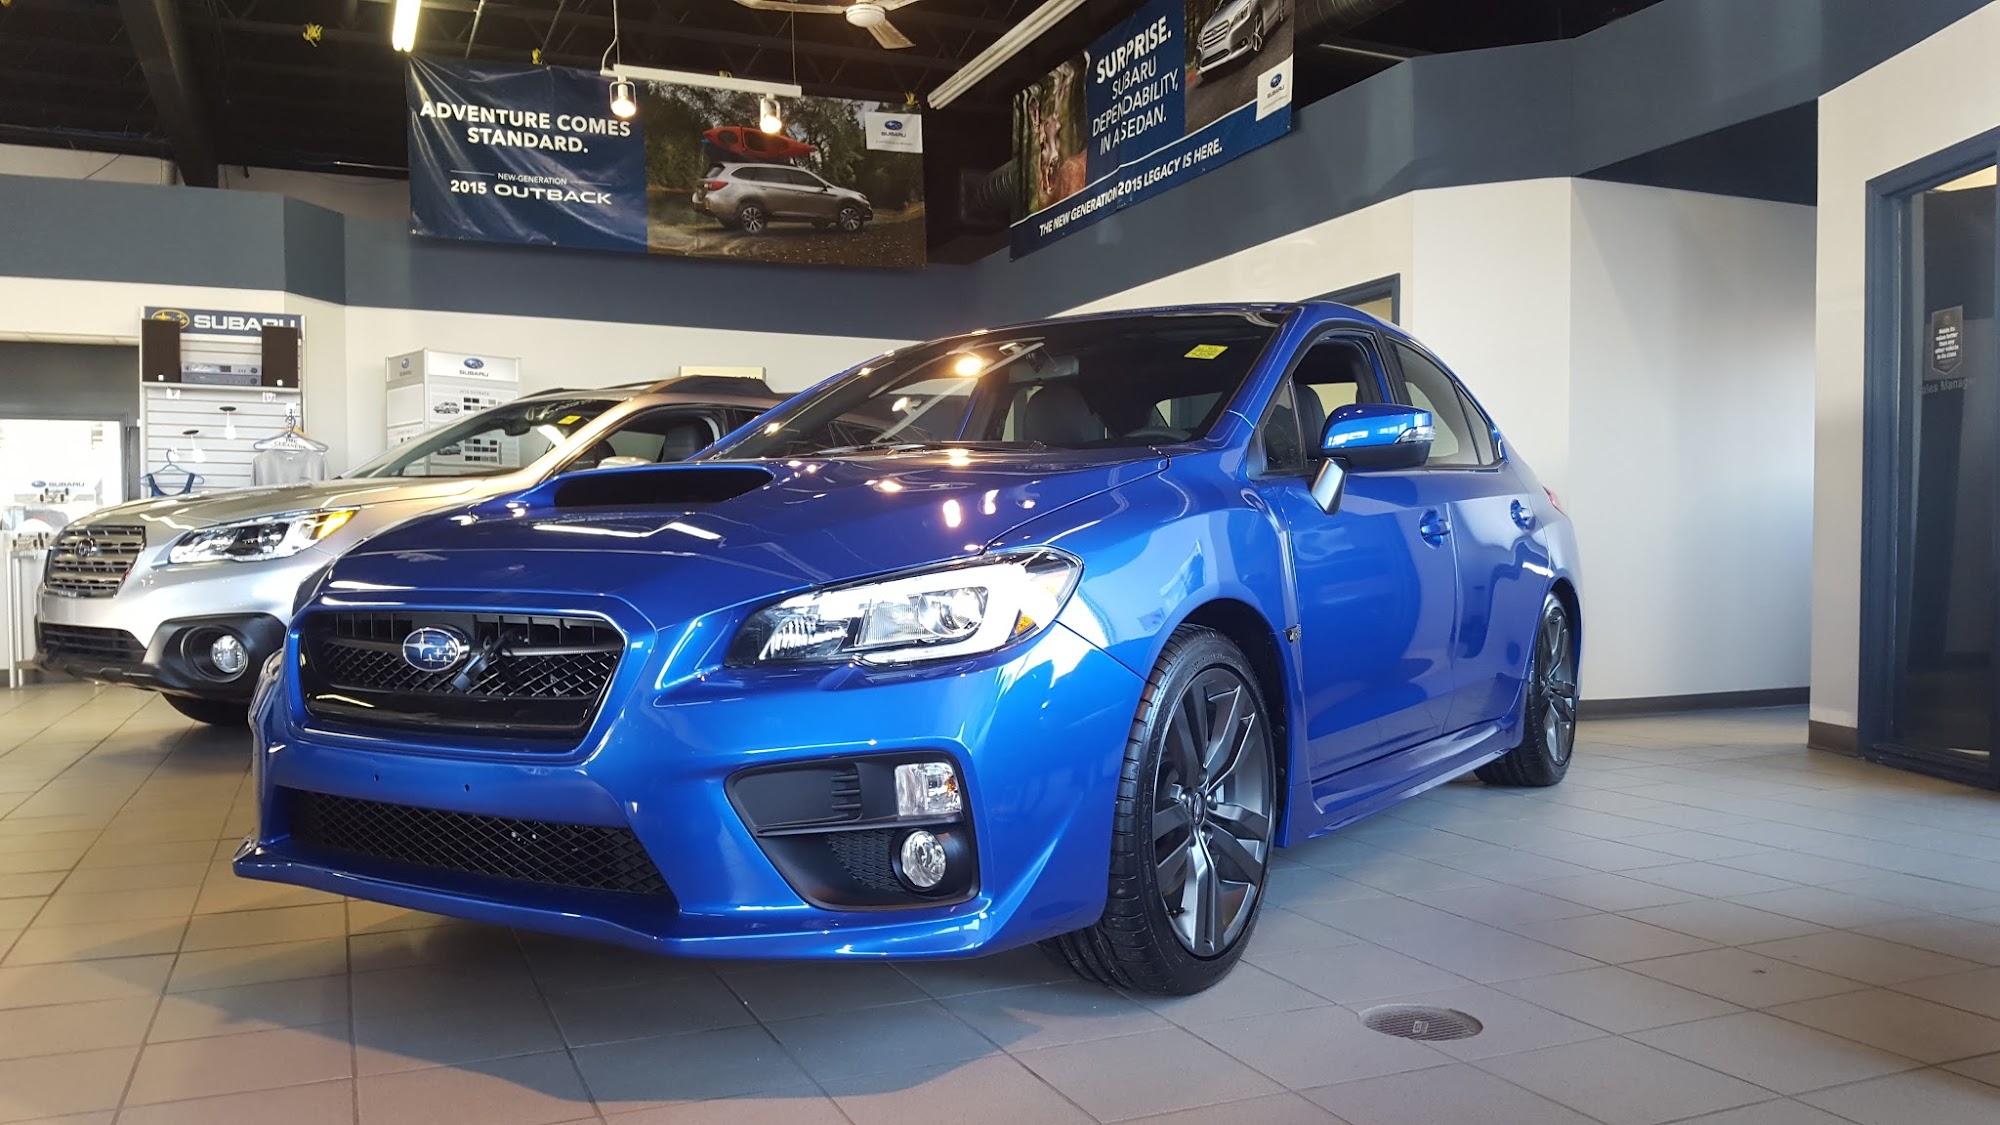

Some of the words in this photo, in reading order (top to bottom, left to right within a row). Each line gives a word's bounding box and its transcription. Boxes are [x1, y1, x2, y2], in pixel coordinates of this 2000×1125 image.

[1096, 15, 1172, 84] SURPRISE.
[1112, 55, 1157, 100] SUBARU
[420, 101, 551, 129] ADVENTURE
[556, 114, 631, 137] COMES
[1092, 68, 1179, 137] DEPENDABILITY,
[467, 127, 589, 153] STANDARD.
[1099, 133, 1111, 156] IN
[1112, 128, 1120, 149] A
[1120, 103, 1167, 141] SEDAN.
[451, 179, 488, 195] 2015
[494, 184, 613, 205] OUTBACK
[497, 172, 568, 185] NEW-GENERATION
[1039, 220, 1053, 237] THE
[1053, 210, 1071, 230] NEW
[1071, 185, 1118, 221] GENERATION
[1117, 175, 1142, 196] 2015
[1143, 156, 1181, 187] LEGACY
[1182, 153, 1192, 169] IS
[1192, 138, 1223, 163] HERE.
[194, 314, 295, 332] SUBARU
